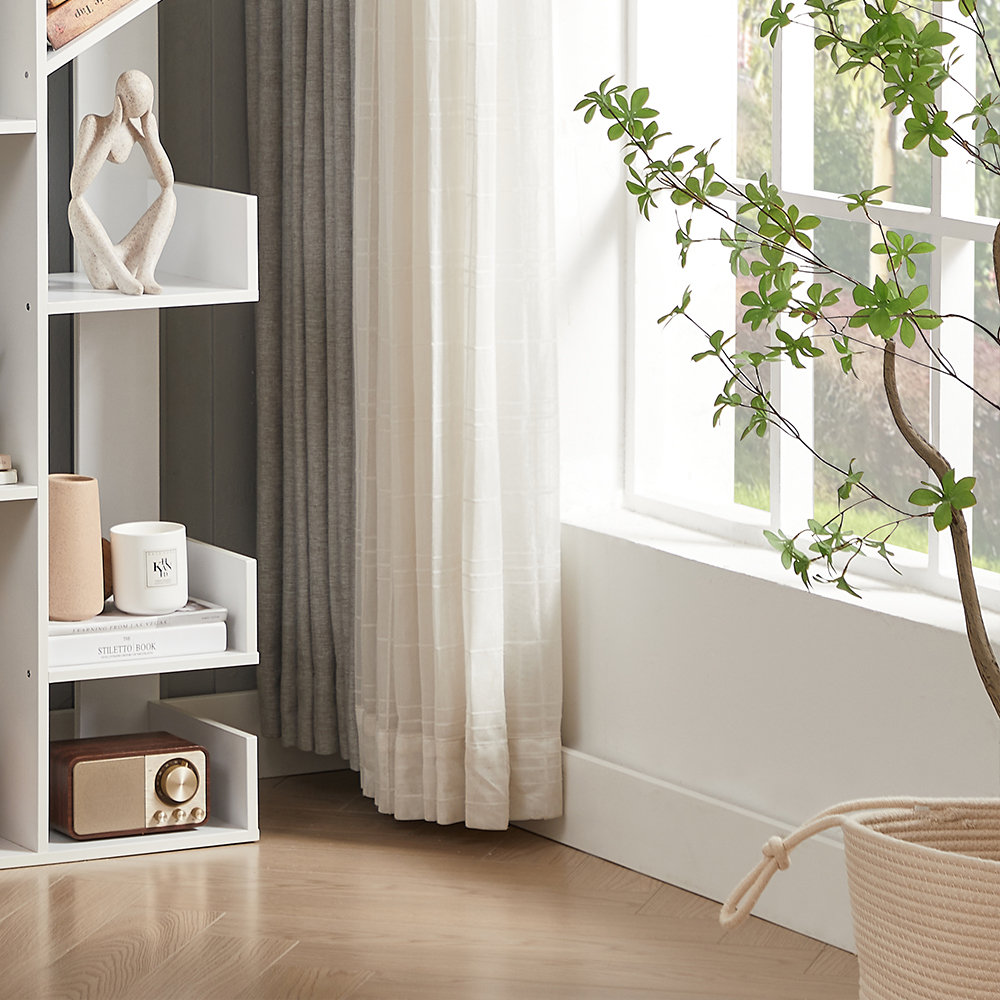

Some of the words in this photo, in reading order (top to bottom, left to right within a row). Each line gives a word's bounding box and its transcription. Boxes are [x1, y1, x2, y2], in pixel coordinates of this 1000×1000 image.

[109, 623, 129, 631] FROM
[97, 645, 133, 655] STILETTO
[135, 642, 156, 652] BOOK
